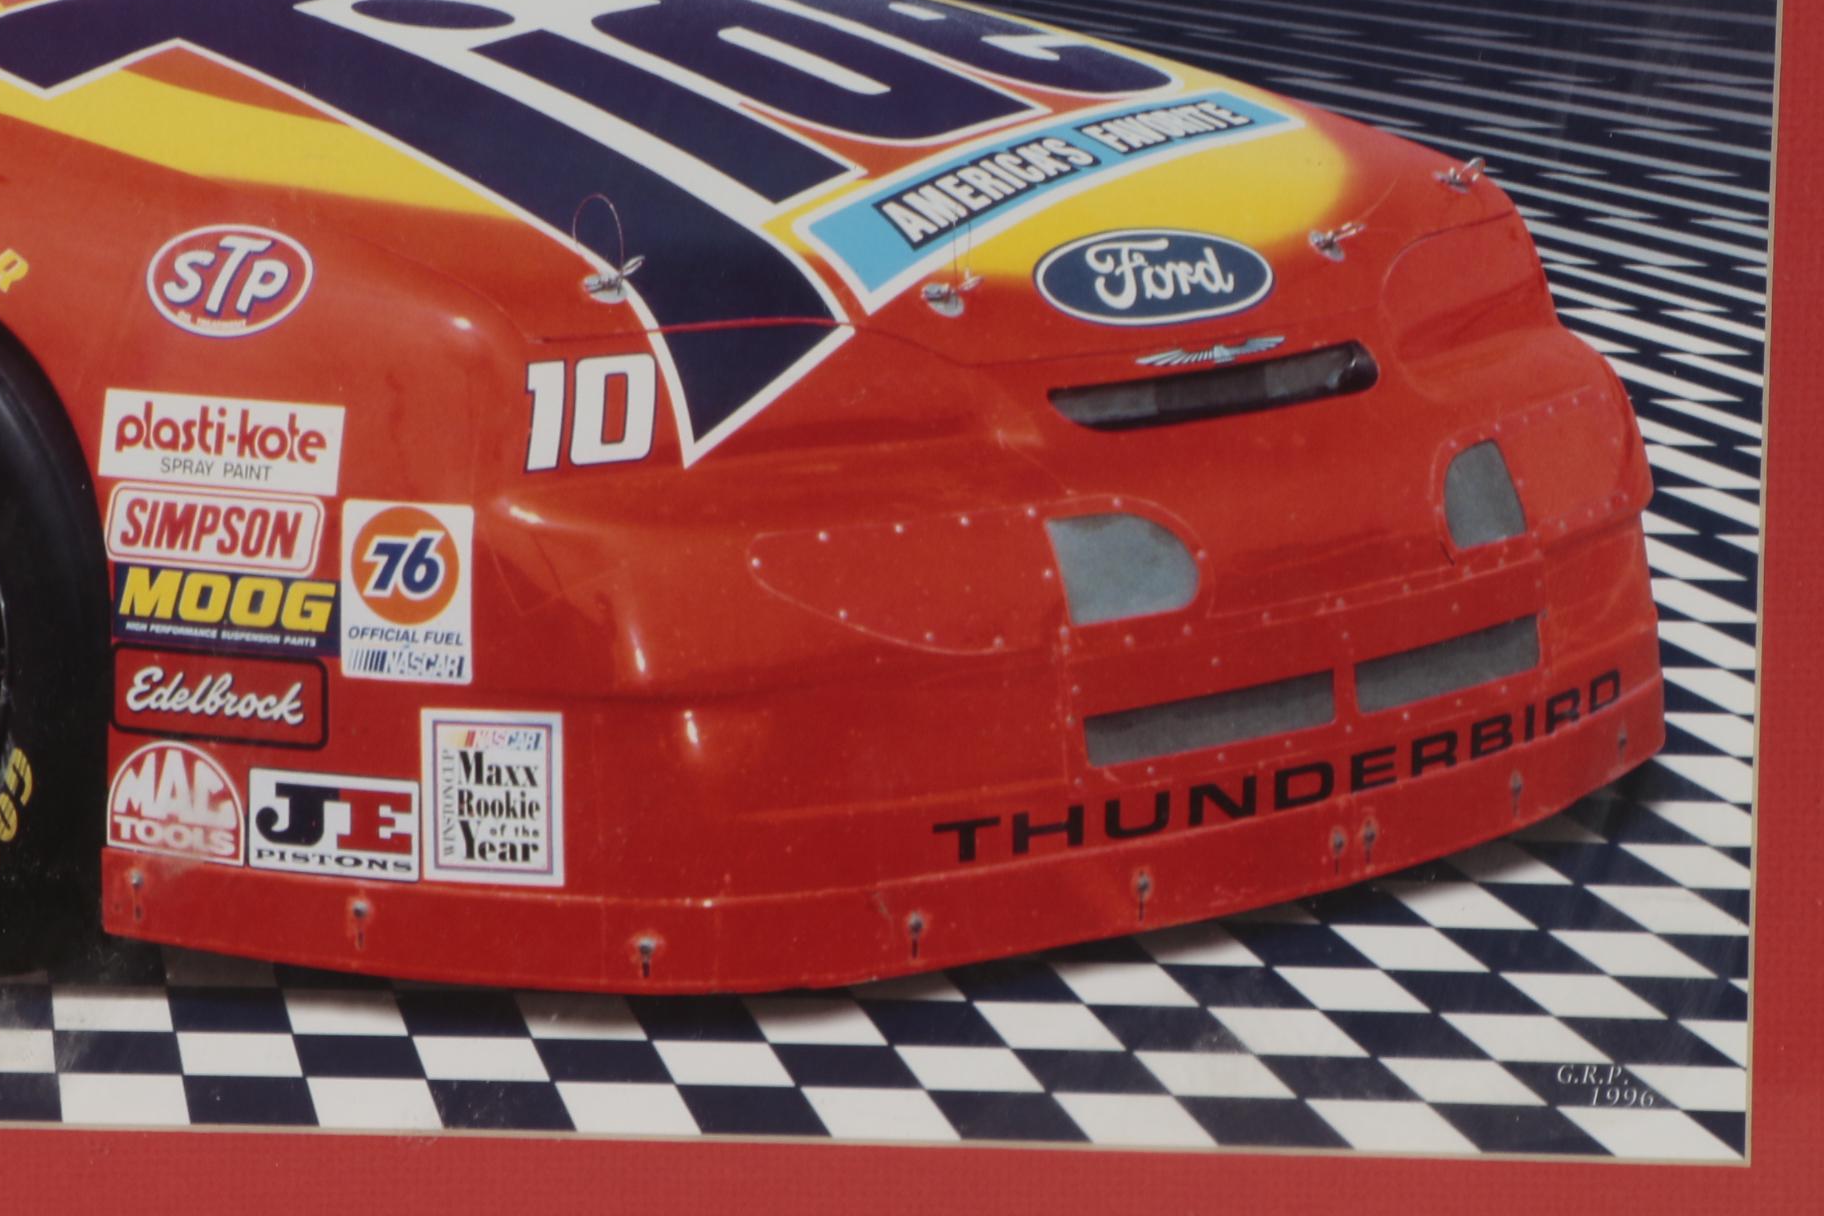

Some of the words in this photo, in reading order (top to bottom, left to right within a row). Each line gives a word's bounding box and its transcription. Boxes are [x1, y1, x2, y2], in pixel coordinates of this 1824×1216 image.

[881, 136, 1097, 244] AMERICA'S
[1081, 100, 1251, 153] FAVORITE
[162, 235, 290, 316] STP
[1084, 237, 1235, 310] Ford
[115, 400, 328, 465] plasti-kote
[525, 353, 657, 474] 10
[160, 456, 214, 478] SPRAY
[223, 463, 273, 482] PAINT
[119, 496, 304, 561] SIMPSON
[369, 535, 443, 597] 76
[119, 567, 336, 633] MOOG
[283, 636, 317, 648] PARTS
[348, 625, 419, 644] OFFICIAL
[423, 630, 464, 646] FUEL
[125, 666, 305, 725] Edelbrock
[113, 748, 237, 828] MAC
[457, 750, 539, 788] Maxx
[932, 668, 1622, 864] THUNDERBIRD
[255, 781, 414, 855] JE
[457, 788, 541, 820] Rookie
[489, 823, 507, 837] of
[514, 824, 540, 838] the
[113, 815, 236, 856] TOOLS
[255, 847, 413, 873] PISTONS
[457, 820, 540, 863] Year
[1556, 1064, 1630, 1085] G.R.P.
[1591, 1087, 1656, 1107] 1996
